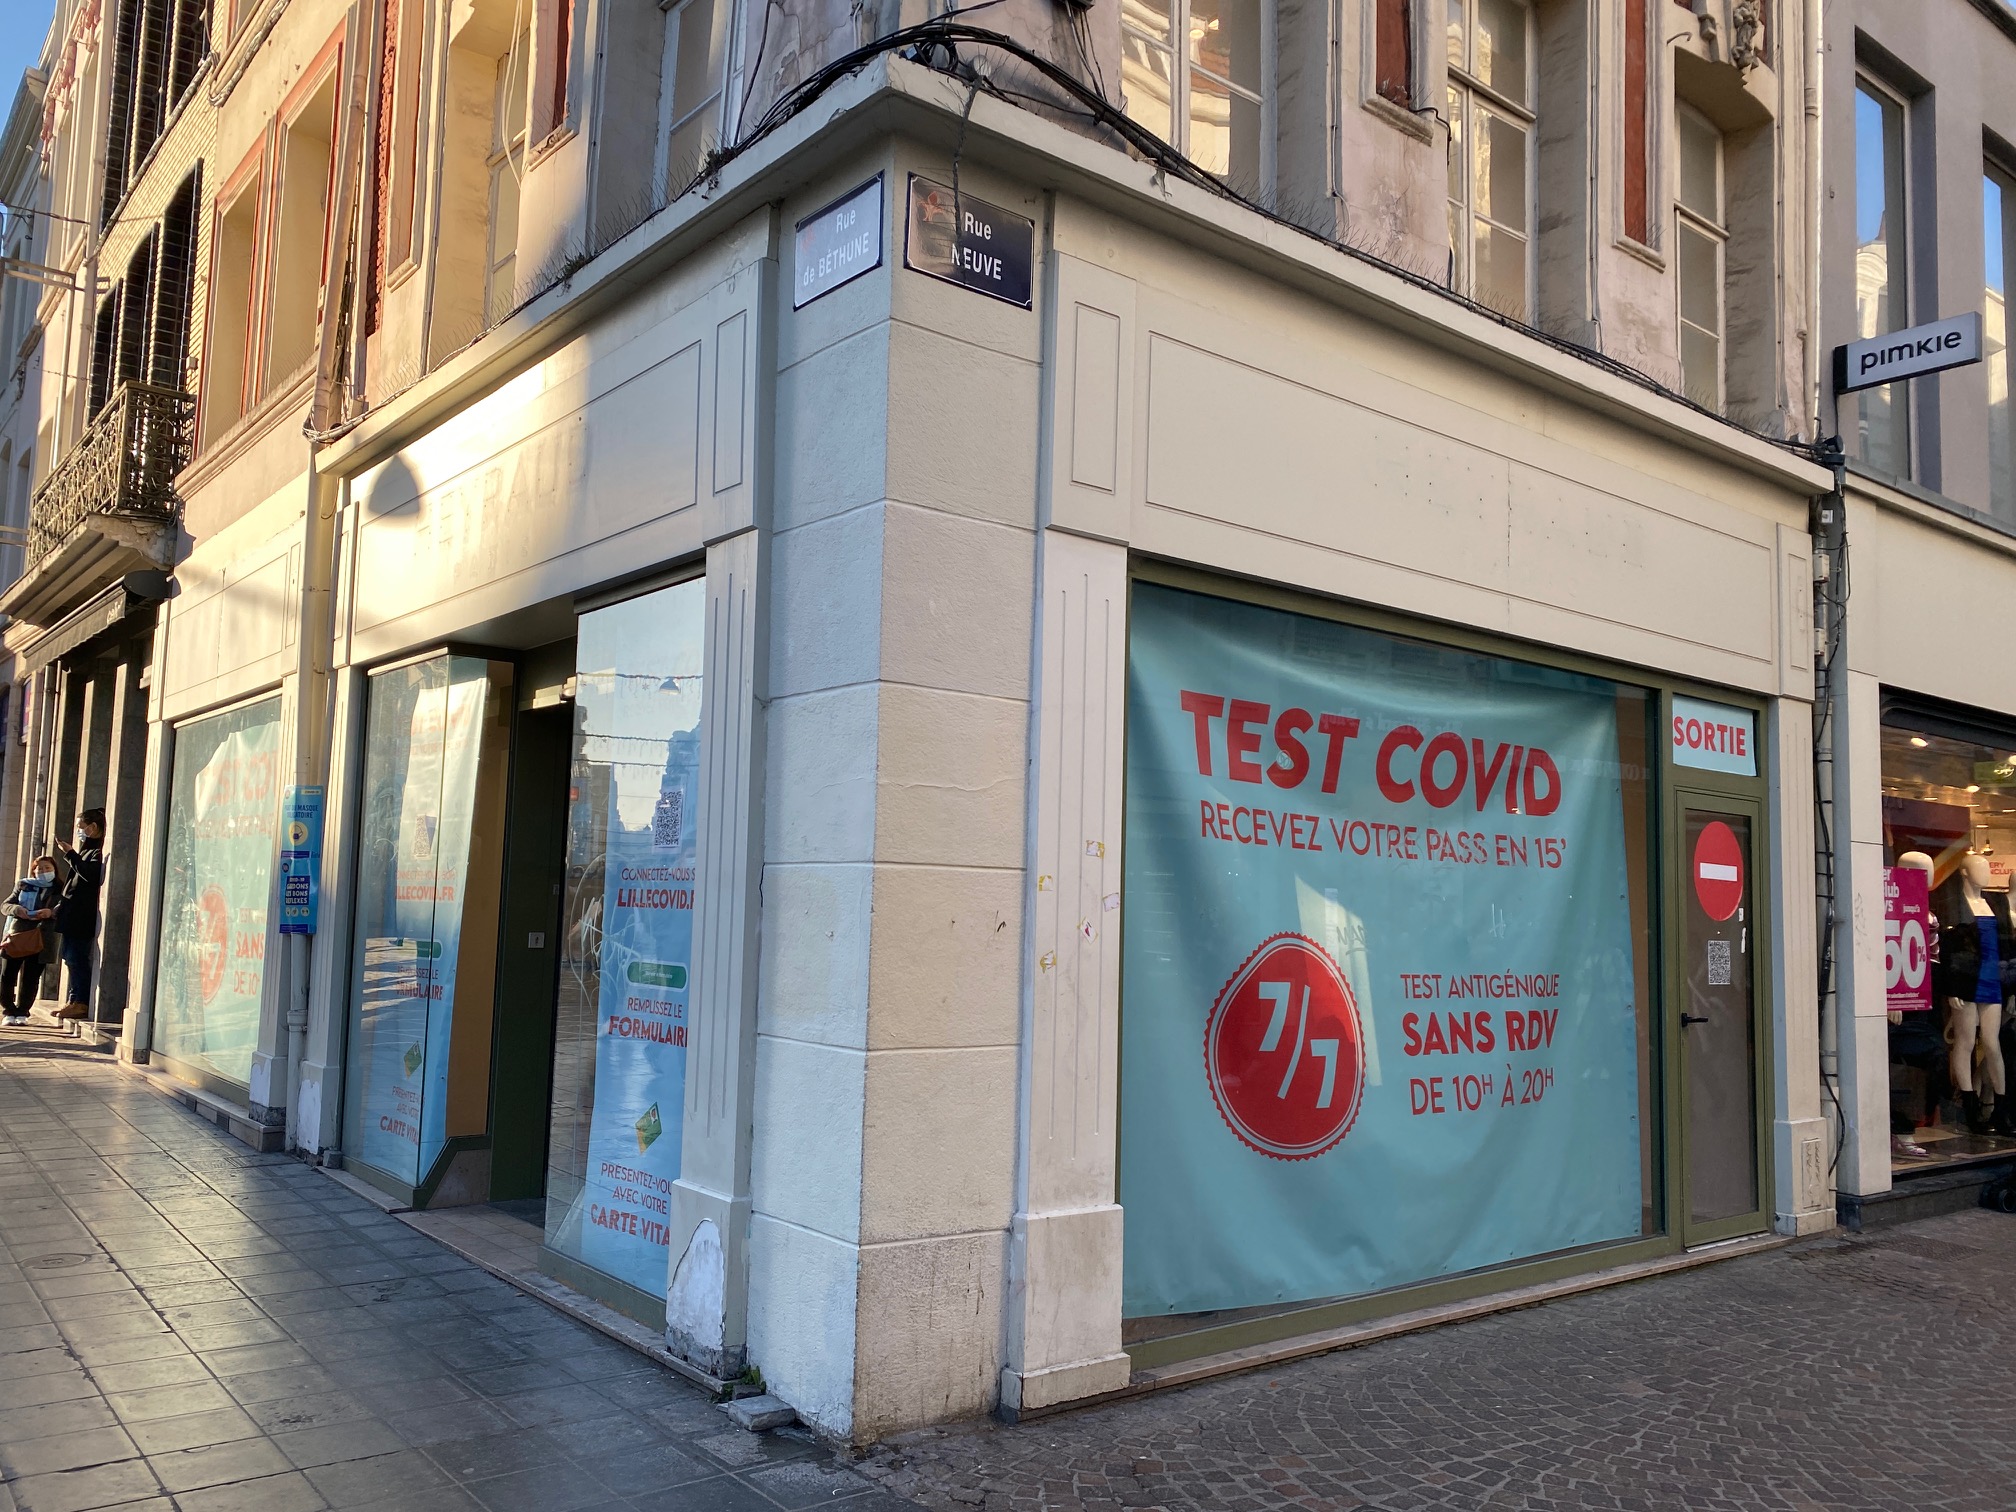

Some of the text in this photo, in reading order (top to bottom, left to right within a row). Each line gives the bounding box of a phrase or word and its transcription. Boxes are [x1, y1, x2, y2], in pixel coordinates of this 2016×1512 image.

[835, 208, 857, 234] Rue
[964, 212, 993, 241] Rue
[802, 232, 870, 287] de BÉTHUNE
[951, 243, 1003, 281] NEUVE
[1860, 330, 1962, 376] pimkie
[1673, 715, 1747, 757] SORTIE
[1180, 690, 1563, 817] TEST COVID
[1201, 799, 1323, 852] RECEVEZ
[1330, 818, 1419, 861] VOTRE
[1427, 828, 1489, 866] PASS
[1495, 836, 1528, 868] EN
[621, 867, 690, 882] CONNECTEZ-VOUS
[236, 931, 264, 960] SANS
[233, 970, 246, 994] DE
[1400, 967, 1560, 999] TEST ANTIGÉNIQUE
[627, 997, 682, 1019] REMPLISSEZ LE
[1257, 981, 1340, 1109] 7/7
[1402, 1007, 1560, 1057] SANS RDV
[1410, 1077, 1445, 1116] DE
[1500, 1063, 1515, 1108] À
[380, 1115, 406, 1137] CARTE
[612, 1186, 668, 1214] AVEC VOTRE
[590, 1204, 637, 1236] CARTE
